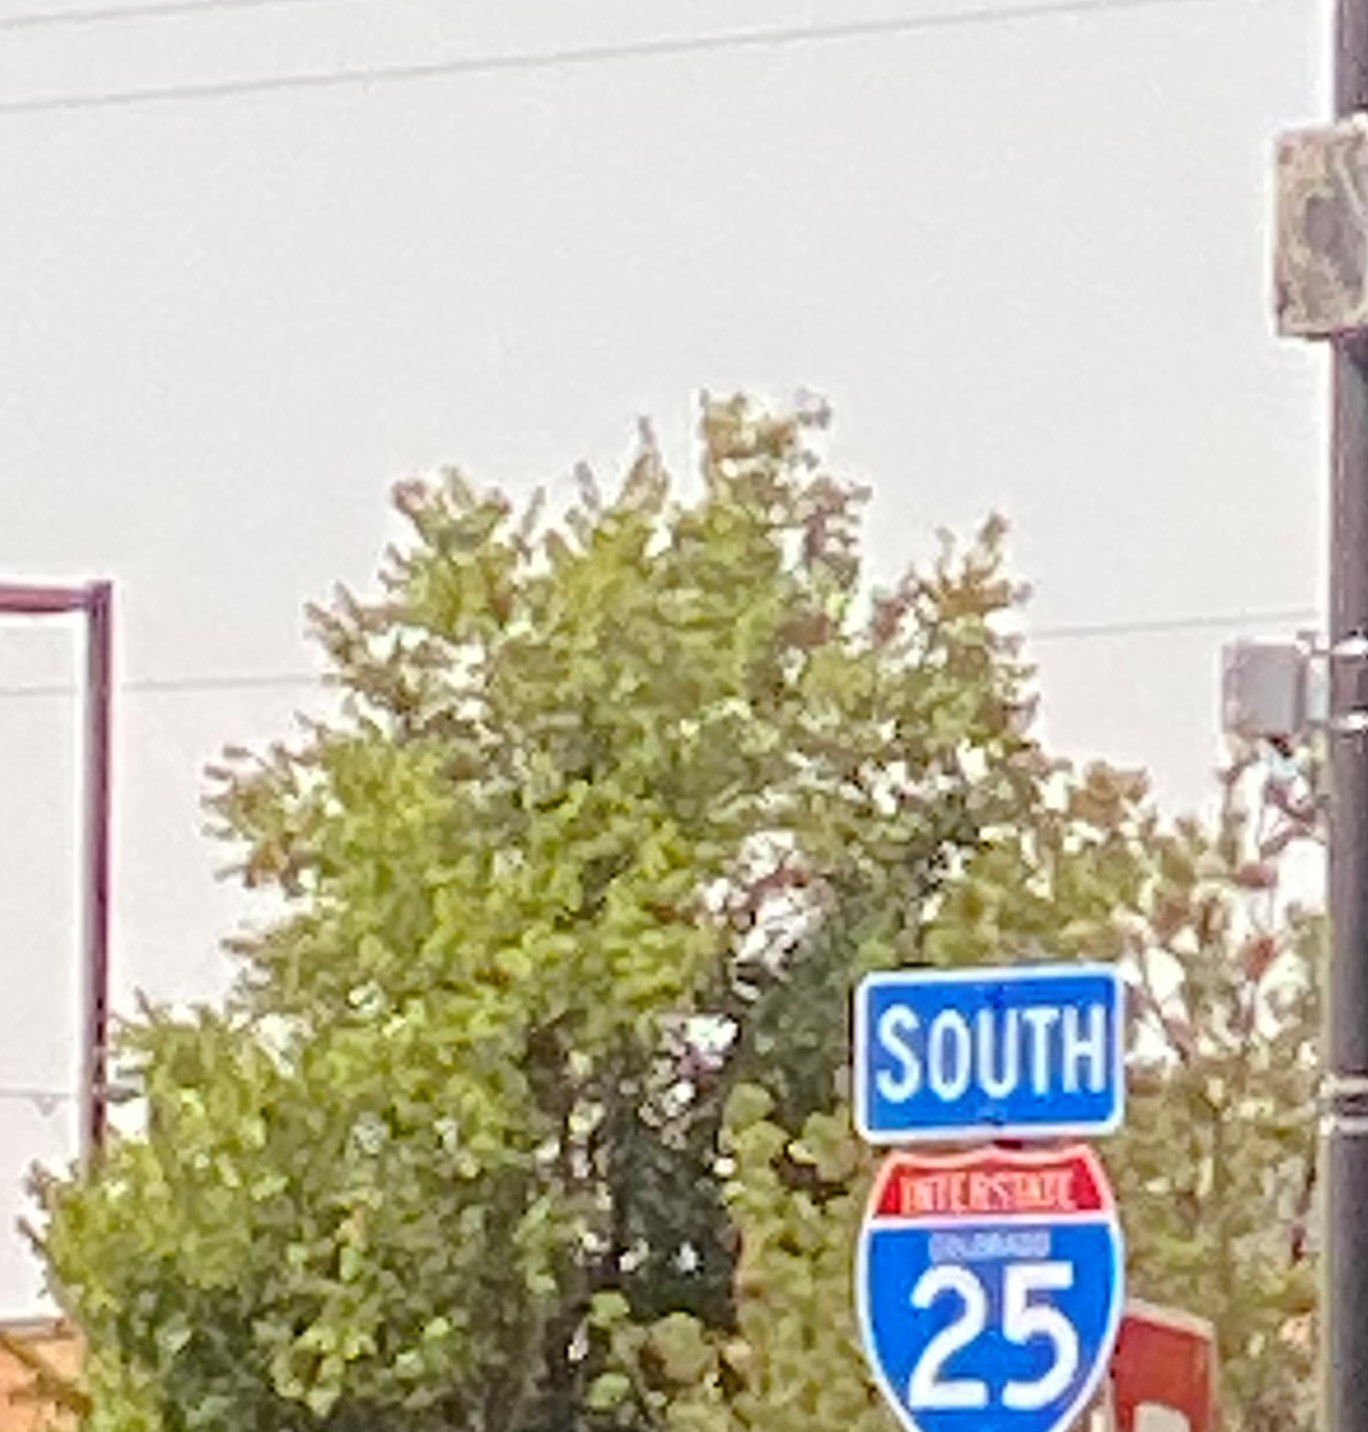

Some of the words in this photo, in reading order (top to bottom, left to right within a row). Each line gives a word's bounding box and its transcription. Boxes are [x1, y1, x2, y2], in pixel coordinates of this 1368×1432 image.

[877, 1004, 1107, 1103] SOUTH
[900, 1170, 1078, 1214] INTERSTATE
[908, 1261, 1080, 1412] 25
